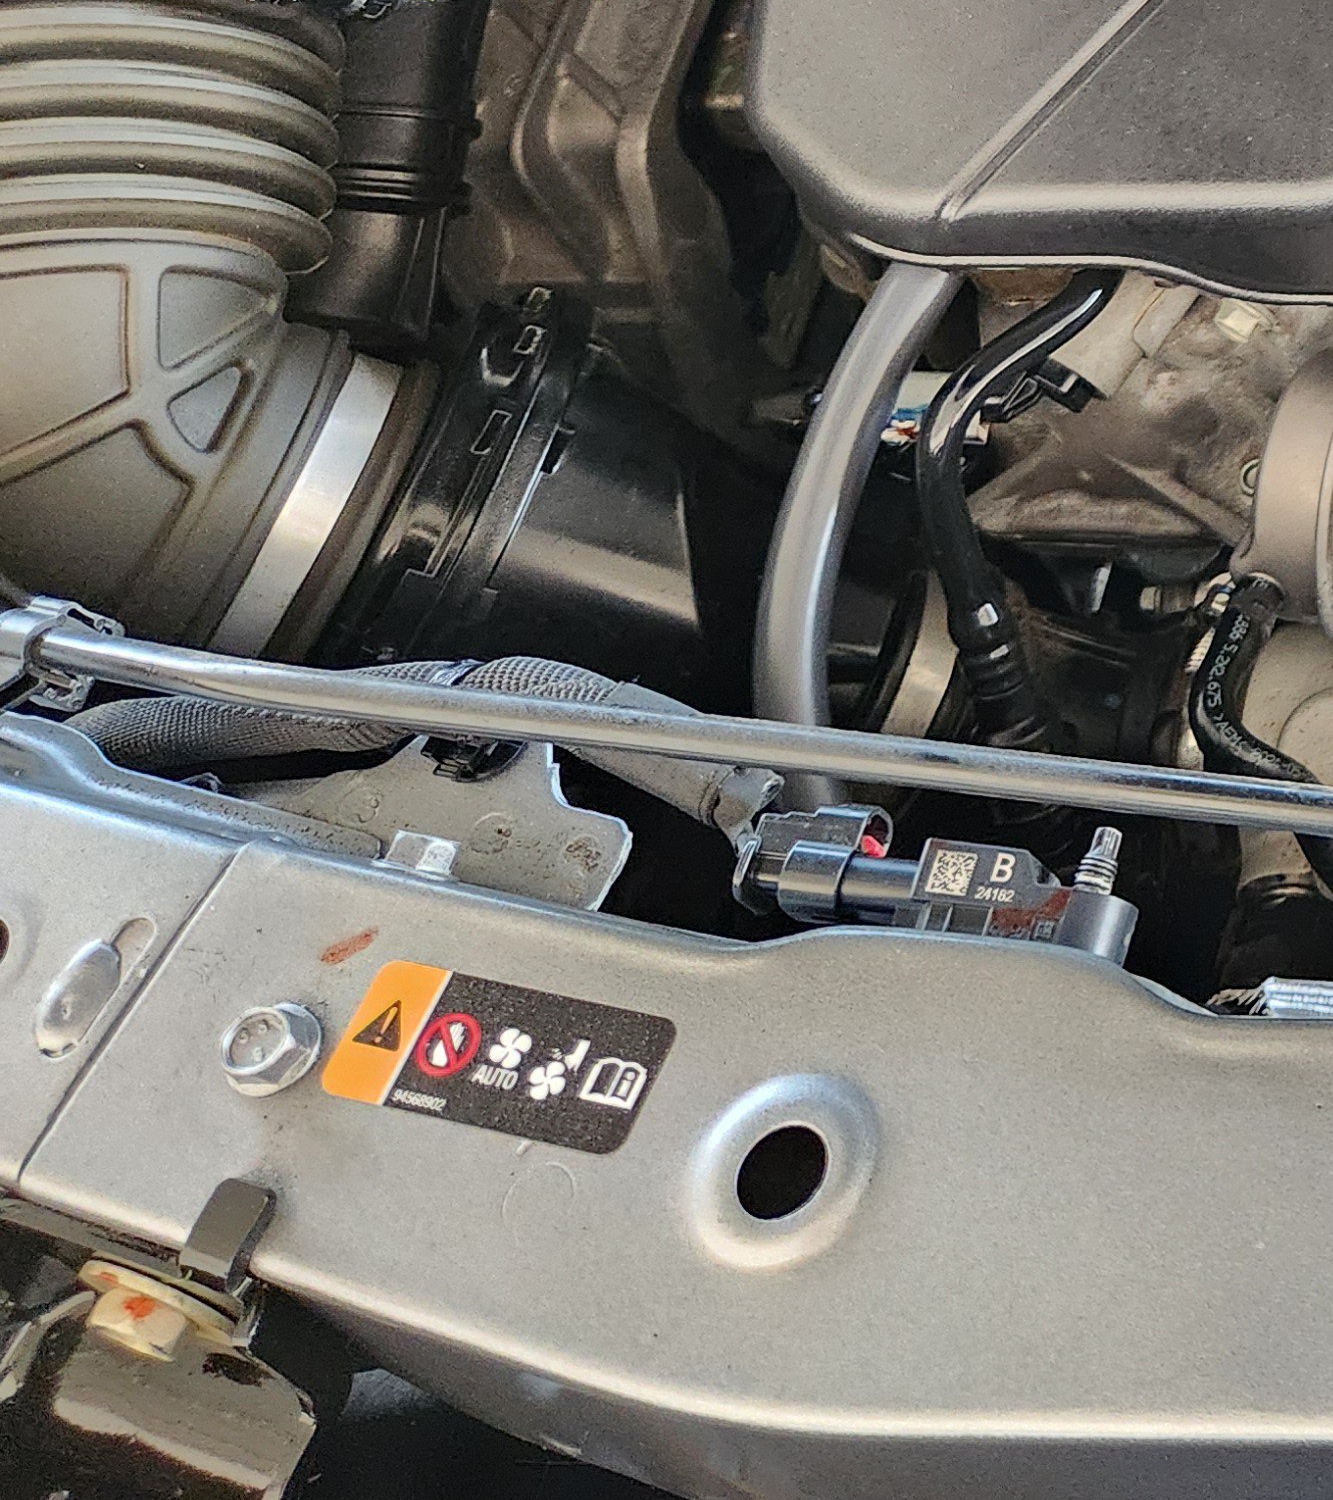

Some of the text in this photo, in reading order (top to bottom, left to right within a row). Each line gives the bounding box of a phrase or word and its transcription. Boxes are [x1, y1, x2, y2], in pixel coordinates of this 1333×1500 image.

[989, 852, 1016, 883] B
[974, 885, 1016, 903] 24182
[471, 1064, 519, 1090] AUTO
